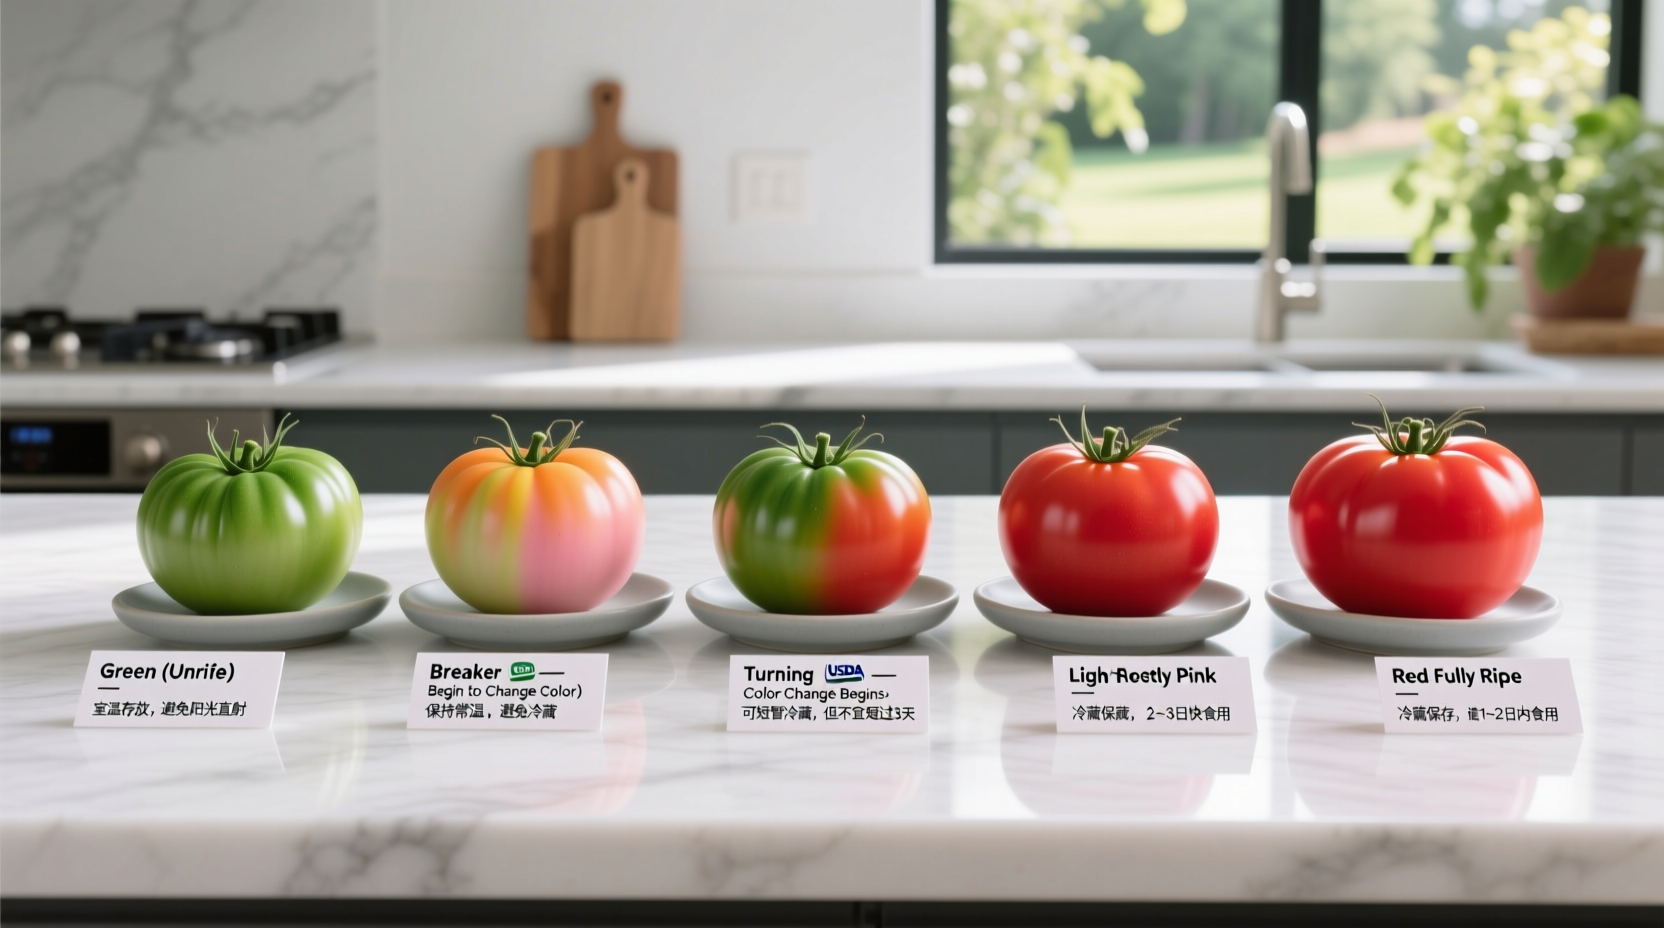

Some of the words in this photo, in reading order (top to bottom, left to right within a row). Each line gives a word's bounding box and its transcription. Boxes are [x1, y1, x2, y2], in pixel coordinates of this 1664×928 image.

[100, 663, 156, 679] Green
[430, 663, 502, 679] Breaker
[744, 666, 813, 685] Turning
[828, 664, 864, 677] USDA
[1177, 667, 1216, 683] Pink
[1392, 668, 1429, 683] Red
[1434, 667, 1475, 688] Fully
[1480, 668, 1522, 688] Ripe
[428, 685, 463, 700] Begin
[469, 685, 481, 696] to
[486, 685, 536, 700] Change
[540, 684, 582, 699] Color)
[744, 687, 782, 699] Color
[784, 687, 836, 703] Change
